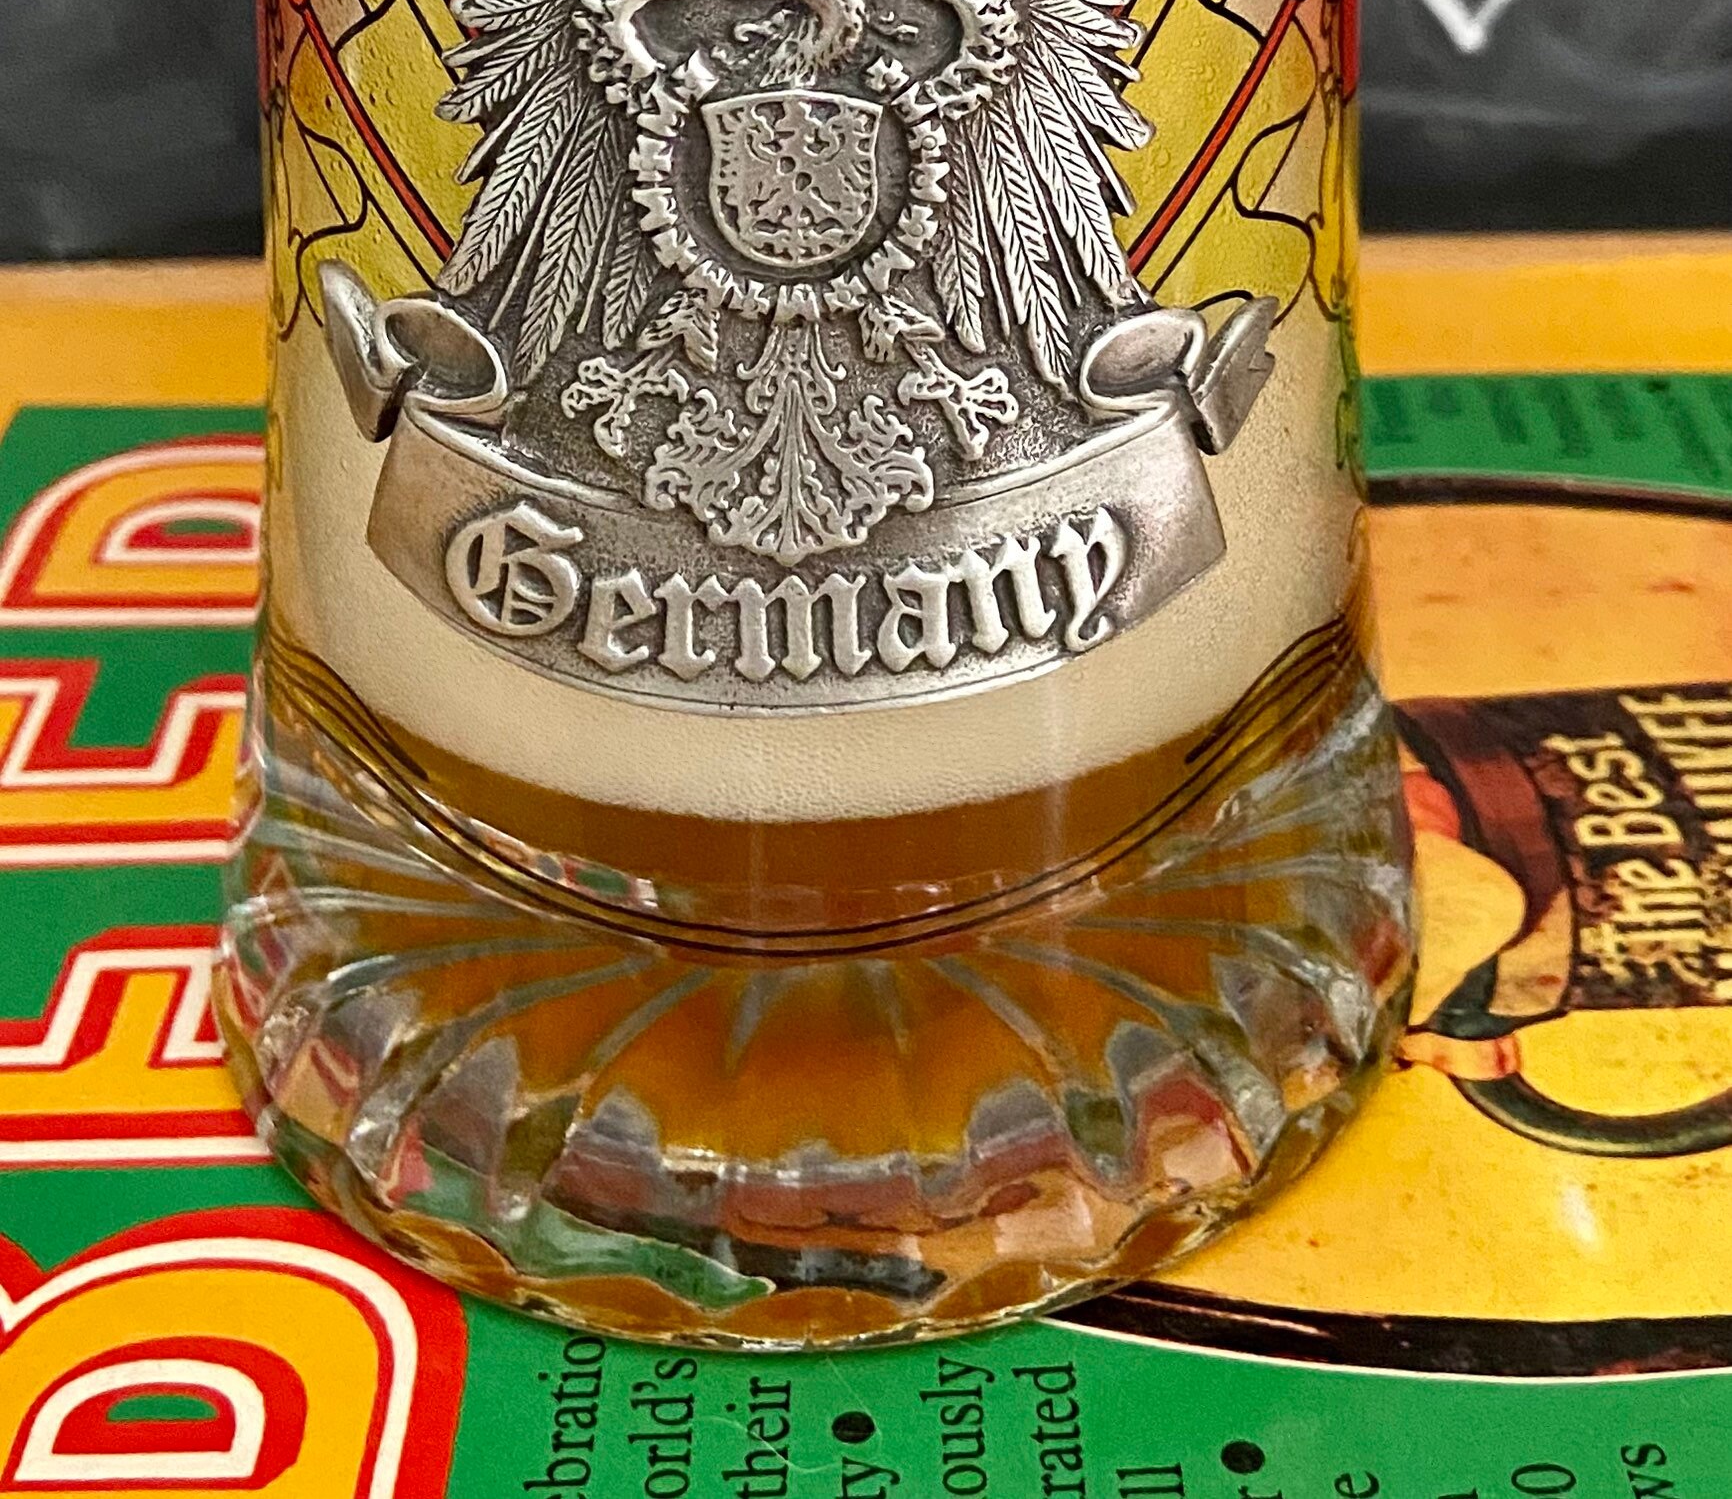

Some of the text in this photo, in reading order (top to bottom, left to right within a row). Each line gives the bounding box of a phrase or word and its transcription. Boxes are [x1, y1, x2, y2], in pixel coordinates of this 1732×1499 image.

[445, 501, 1128, 682] Germany
[1539, 732, 1684, 846] Best
[523, 1335, 607, 1499] bratio
[1011, 1361, 1086, 1499] rated
